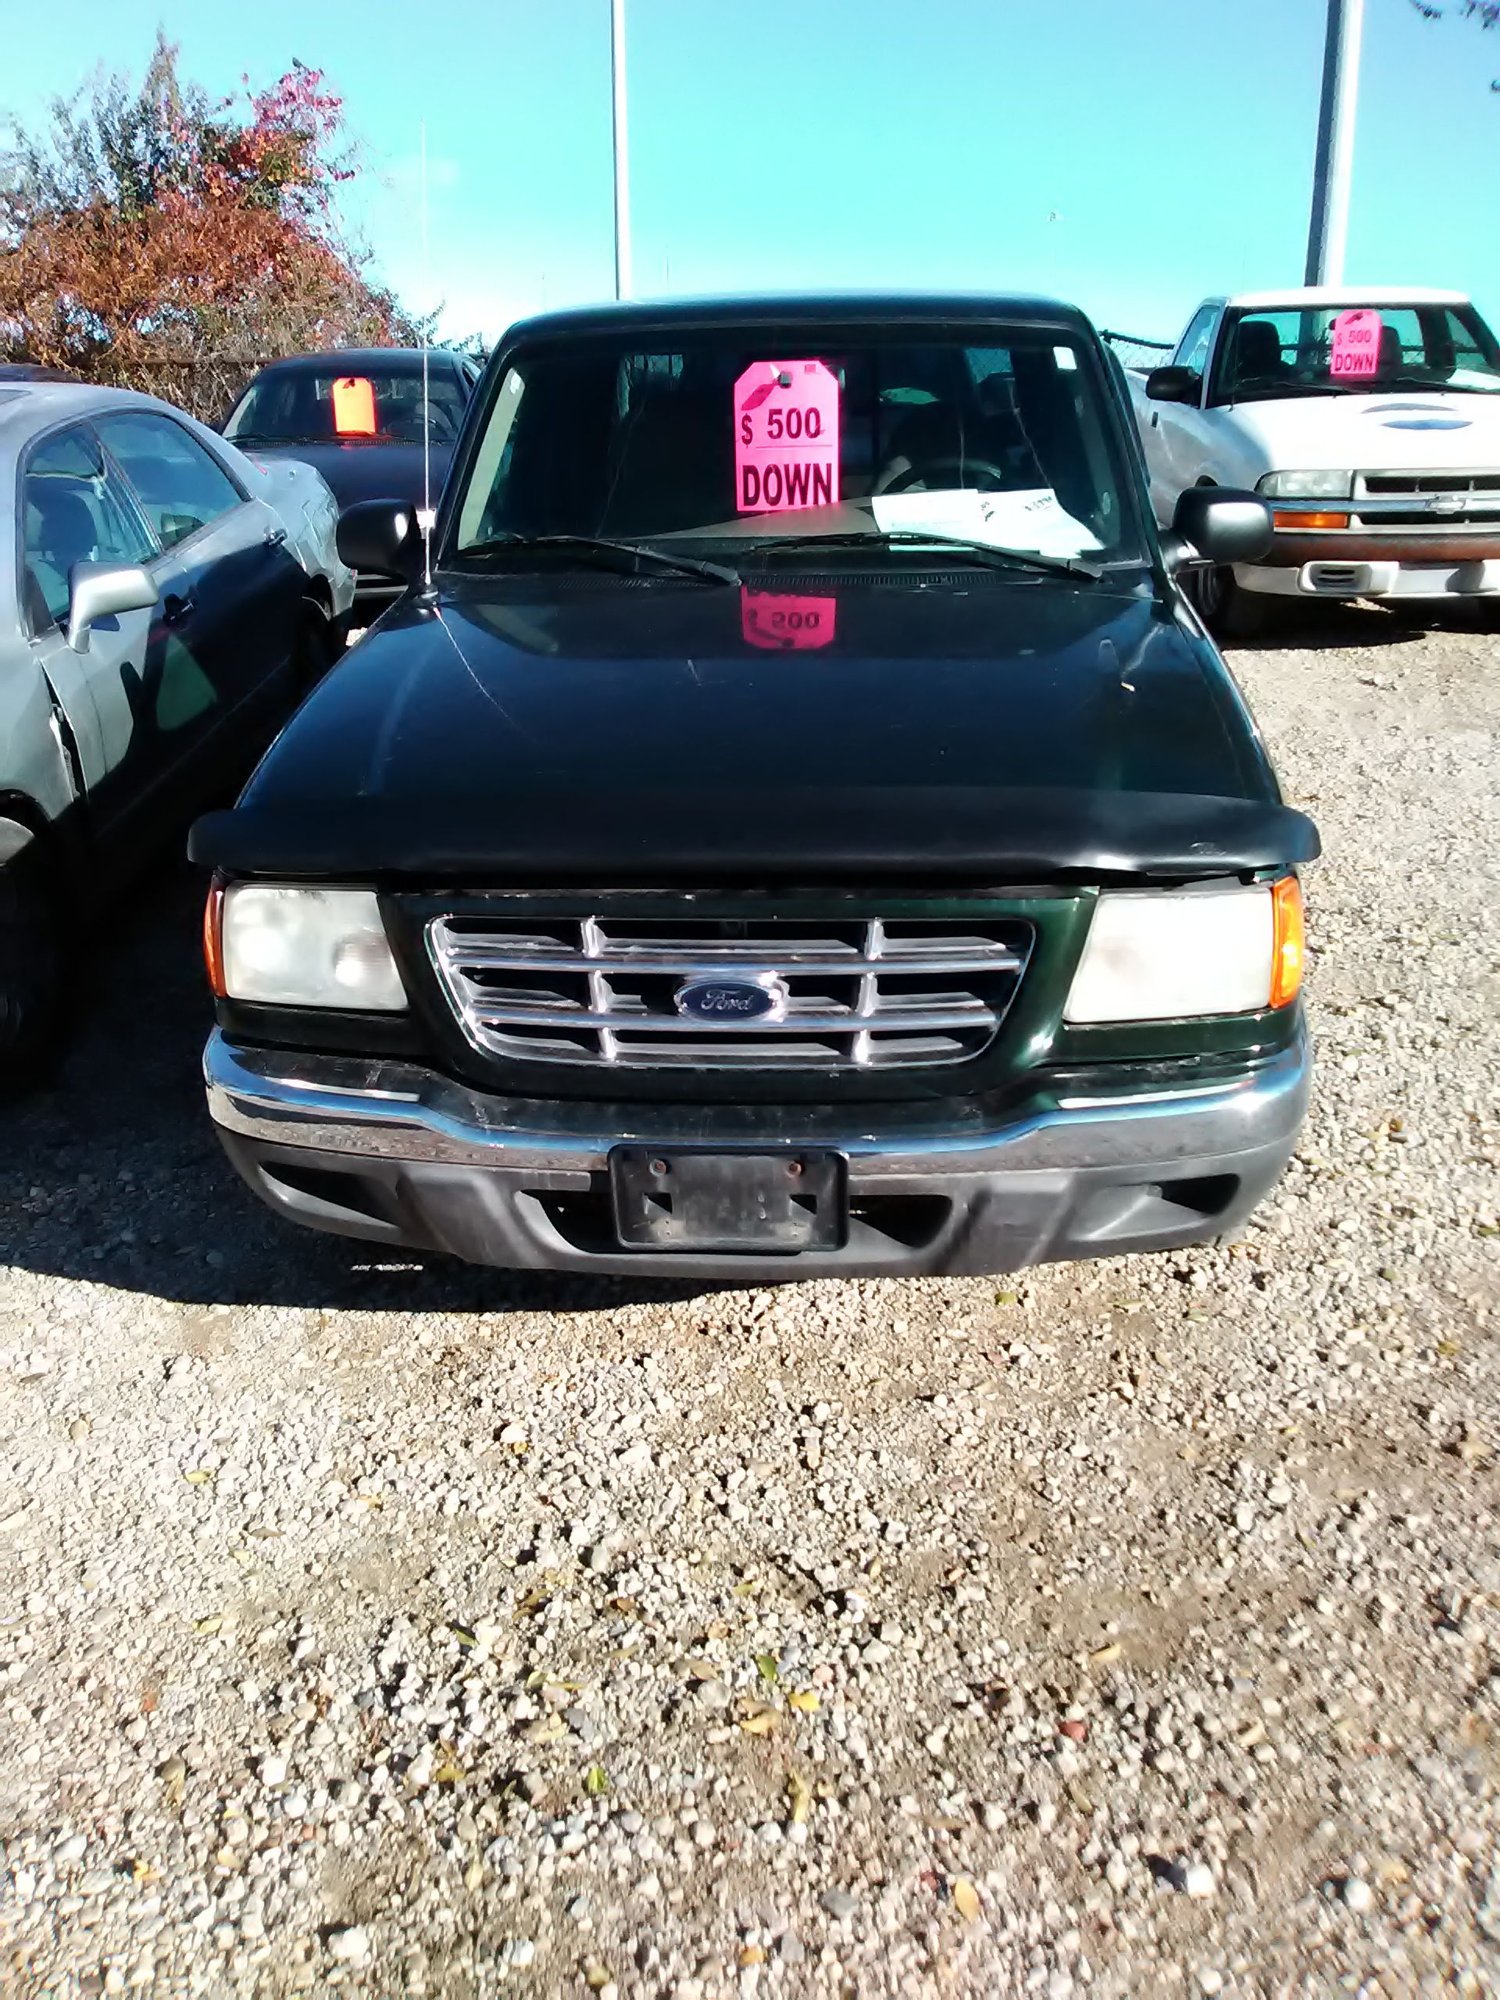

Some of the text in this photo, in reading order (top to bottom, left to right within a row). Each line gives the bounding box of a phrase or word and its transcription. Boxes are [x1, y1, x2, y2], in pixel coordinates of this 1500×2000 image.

[1349, 330, 1372, 343] 500
[1334, 353, 1374, 371] DOWN
[741, 407, 822, 448] $ 500
[742, 463, 832, 507] DOWN
[701, 988, 754, 1010] Ford
